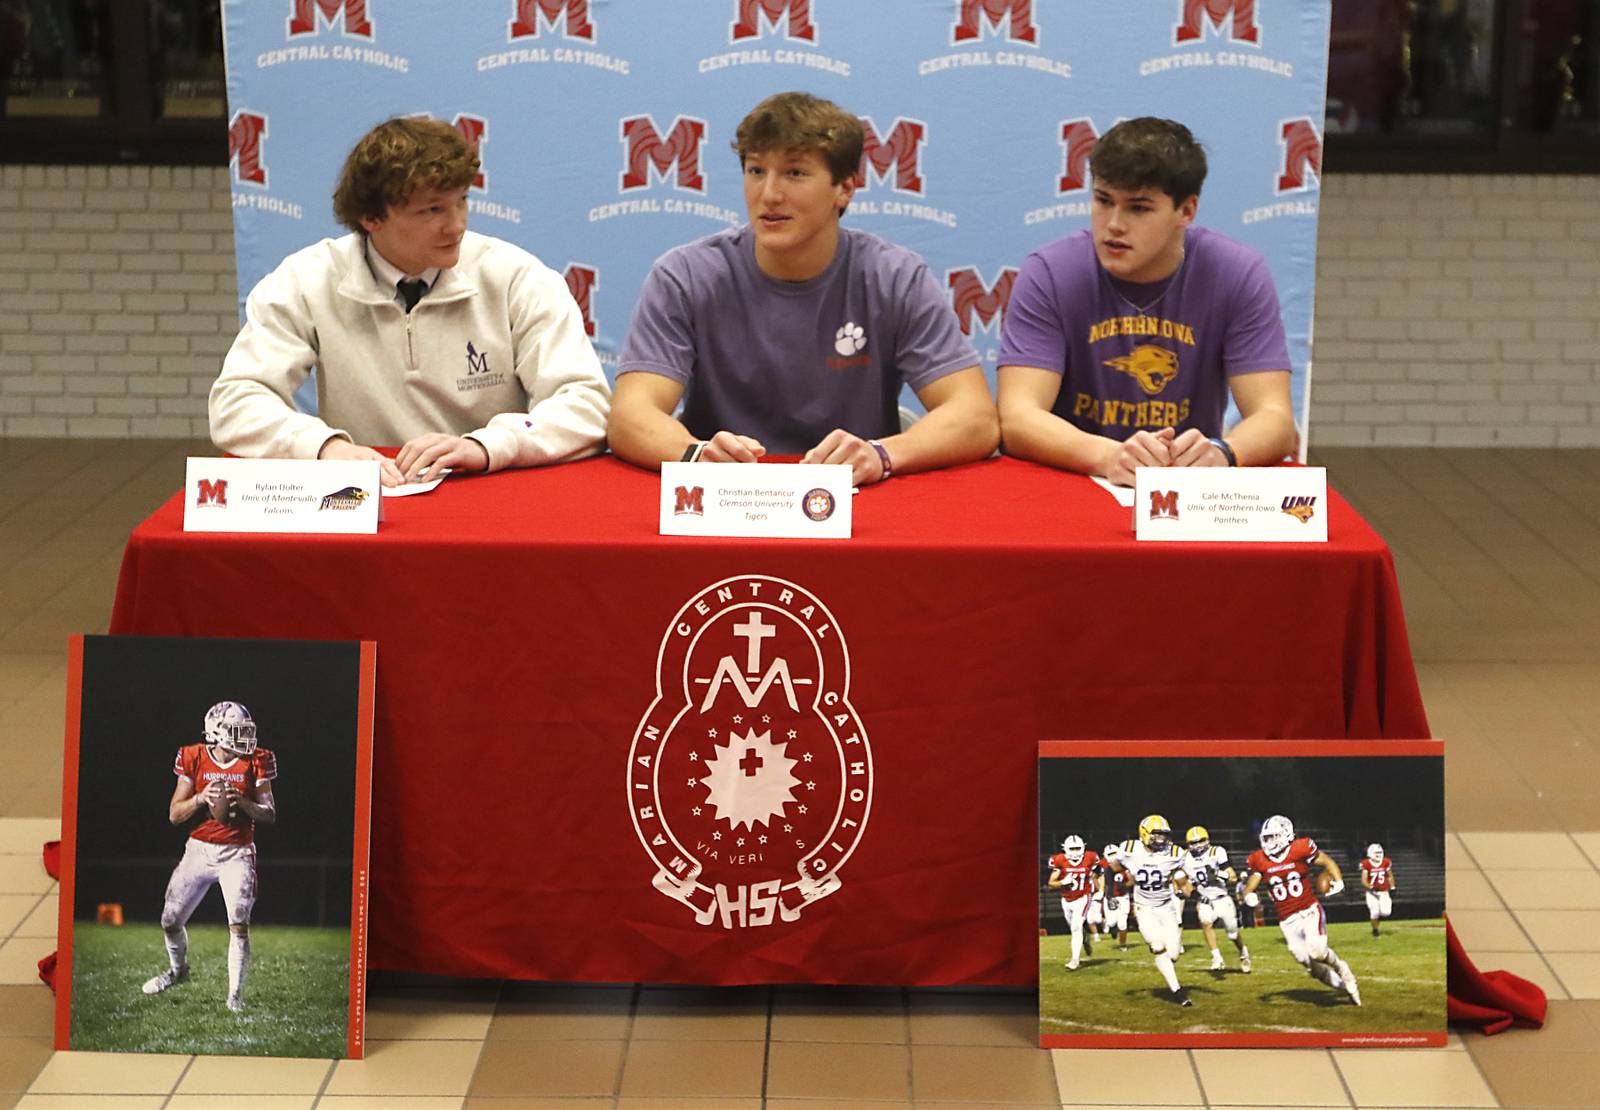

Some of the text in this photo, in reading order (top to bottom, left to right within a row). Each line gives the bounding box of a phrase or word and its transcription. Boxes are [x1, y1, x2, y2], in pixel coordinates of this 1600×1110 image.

[257, 45, 409, 73] CENTRAL CATHOLIC
[477, 48, 630, 75] CENTRAL CATHOLIC
[698, 50, 851, 77] CENTRAL CATHOLIC
[918, 51, 1072, 78] CENTRAL CATHOLIC
[1139, 52, 1293, 78] CENTRAL CATHOLIC
[618, 113, 708, 196] M
[589, 199, 740, 225] CENTRAL CATHOLIC
[882, 201, 957, 227] CATHOLIC
[1243, 201, 1316, 224] CENTRAL
[466, 352, 491, 375] M
[1073, 393, 1191, 427] PANTHERS
[196, 478, 228, 507] M
[255, 483, 278, 492] Rylan
[261, 494, 271, 502] of
[271, 494, 318, 502] Montevallo
[674, 485, 705, 514] M
[717, 488, 795, 497] Christian Bentancur
[1202, 493, 1260, 501] Cale McThenia
[719, 499, 794, 509] Clemson University
[745, 512, 768, 521] Tigers
[1150, 490, 1179, 518] M
[1208, 504, 1217, 513] of
[1218, 504, 1254, 512] Northern
[1255, 504, 1276, 512] Iowa
[1281, 496, 1317, 511] UNI
[1213, 516, 1248, 524] Panthers
[676, 582, 832, 639] CENTRAL
[203, 773, 245, 783] HURRICANES
[812, 690, 865, 873] CATHOLIC
[635, 724, 688, 874] MARIAN
[696, 840, 719, 861] VIA
[729, 853, 764, 866] VERI
[1137, 869, 1163, 892] 22
[1370, 871, 1386, 885] 75
